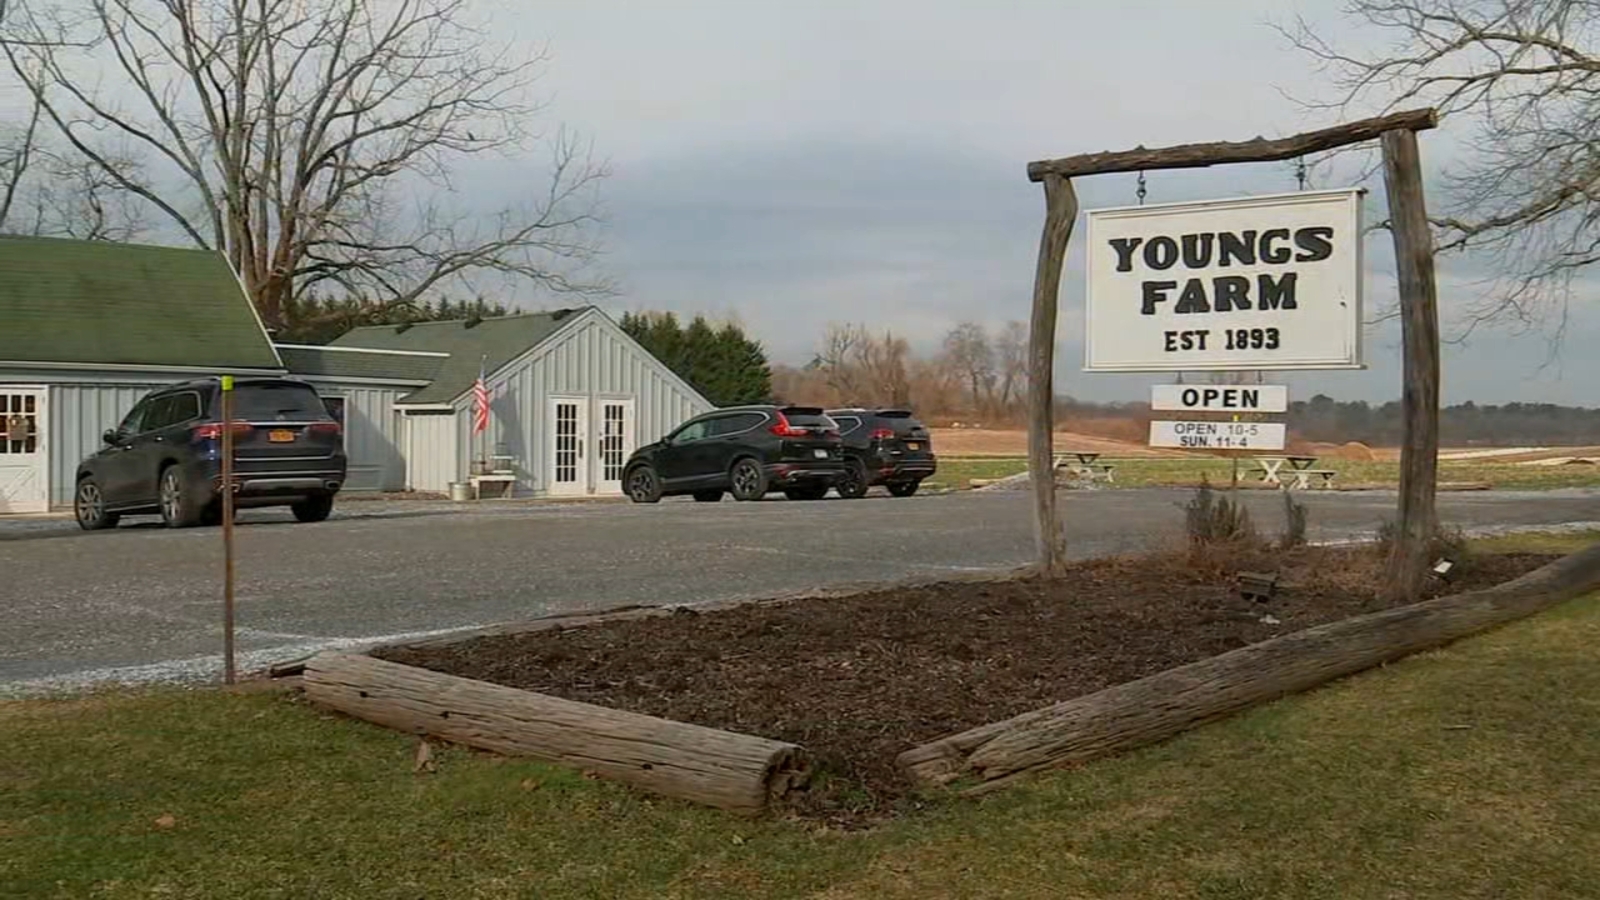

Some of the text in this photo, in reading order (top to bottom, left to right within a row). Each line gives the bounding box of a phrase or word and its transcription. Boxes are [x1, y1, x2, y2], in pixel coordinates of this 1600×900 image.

[1108, 226, 1334, 272] YOUNGS
[1140, 272, 1297, 315] FARM
[1164, 328, 1280, 351] EST 1893
[1181, 388, 1259, 408] OPEN
[1174, 423, 1259, 436] OPEN 10-5
[1180, 436, 1213, 447] SUN.
